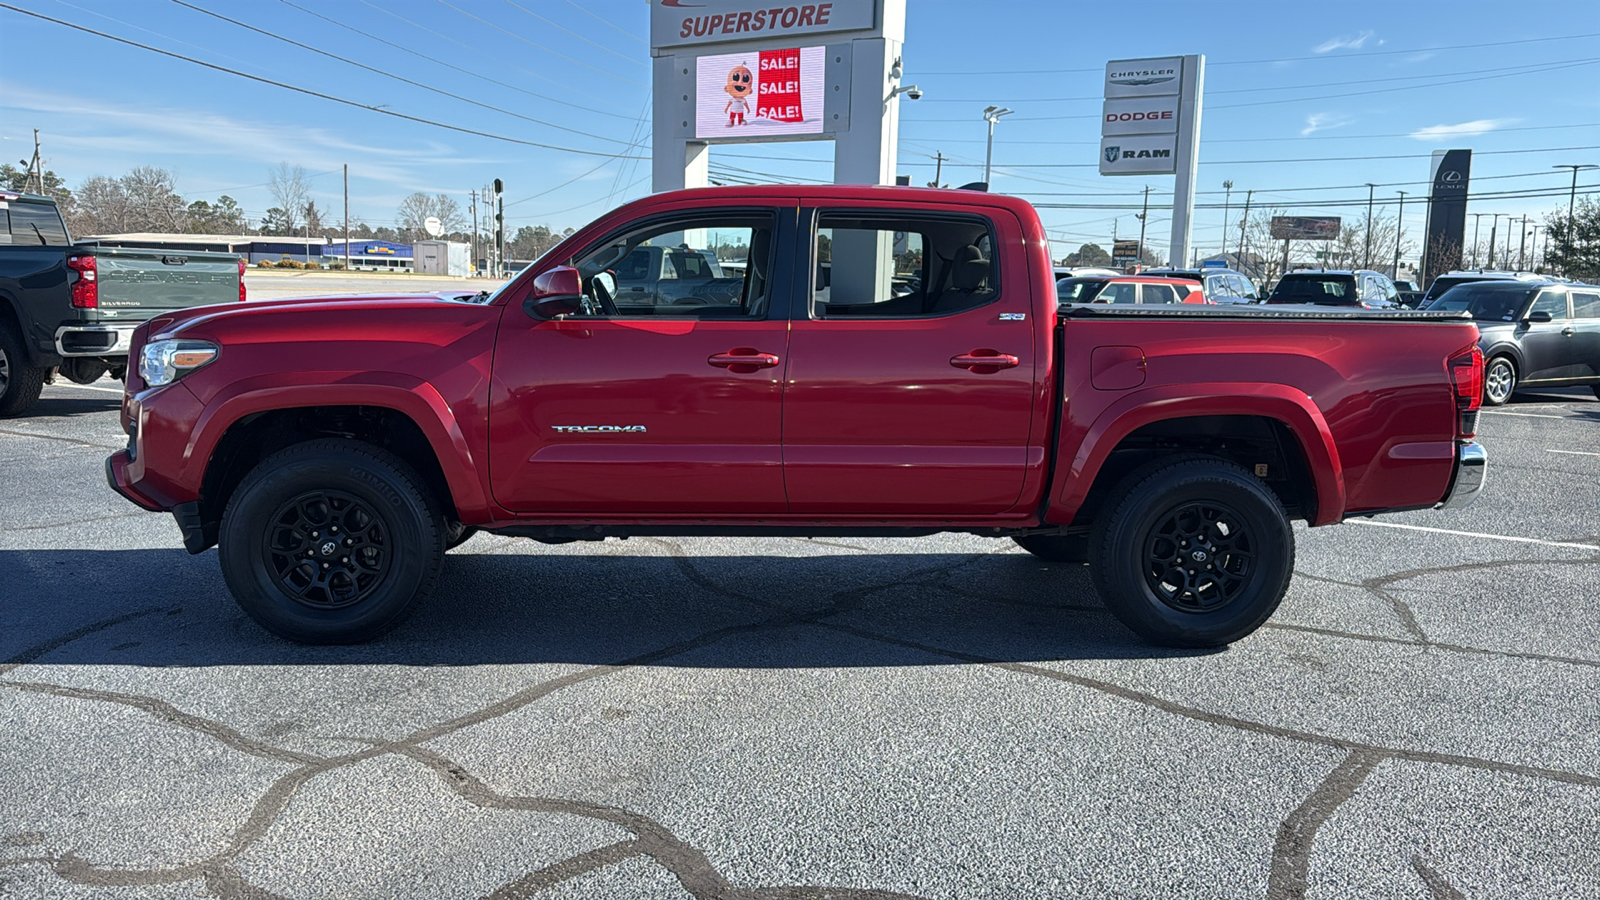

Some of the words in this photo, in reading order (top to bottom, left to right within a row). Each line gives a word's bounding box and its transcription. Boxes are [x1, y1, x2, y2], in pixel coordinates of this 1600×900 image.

[679, 3, 833, 38] SUPERSTORE
[760, 57, 798, 70] SALE!
[1110, 69, 1174, 78] CHRYSLER
[760, 81, 798, 94] SALE!
[758, 106, 799, 119] SALE!
[1106, 111, 1173, 122] DODGE
[1122, 149, 1170, 158] RAM
